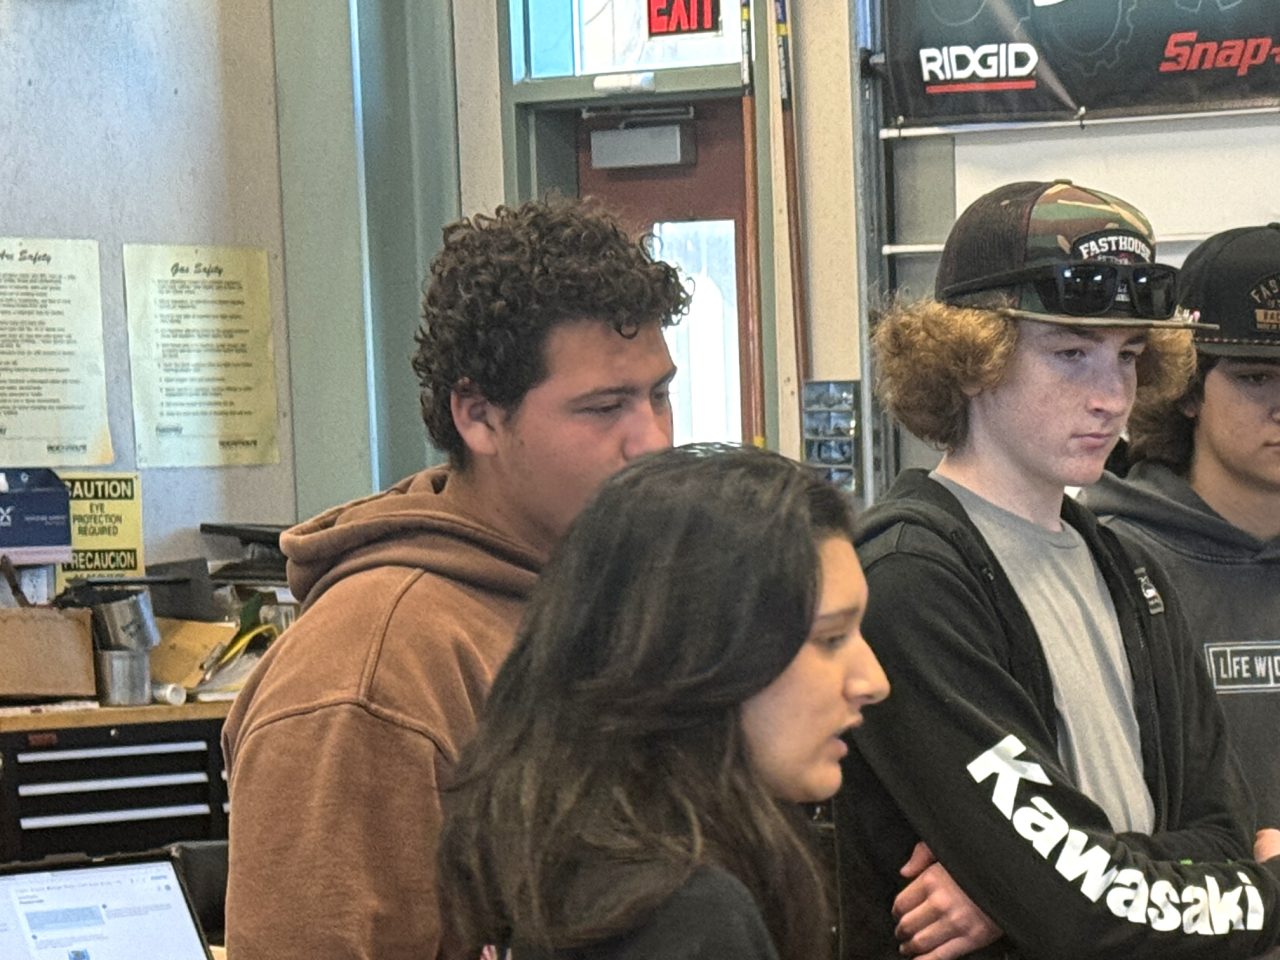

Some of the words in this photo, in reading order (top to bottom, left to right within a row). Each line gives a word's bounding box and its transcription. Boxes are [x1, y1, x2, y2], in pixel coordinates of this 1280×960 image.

[920, 42, 1038, 82] RIDGID
[193, 262, 224, 278] Safety
[89, 502, 105, 514] EYE
[72, 514, 122, 525] PROTECTION
[78, 526, 118, 536] REQUIRED
[1219, 652, 1251, 678] LIFE
[966, 734, 1265, 936] Kawasaki
